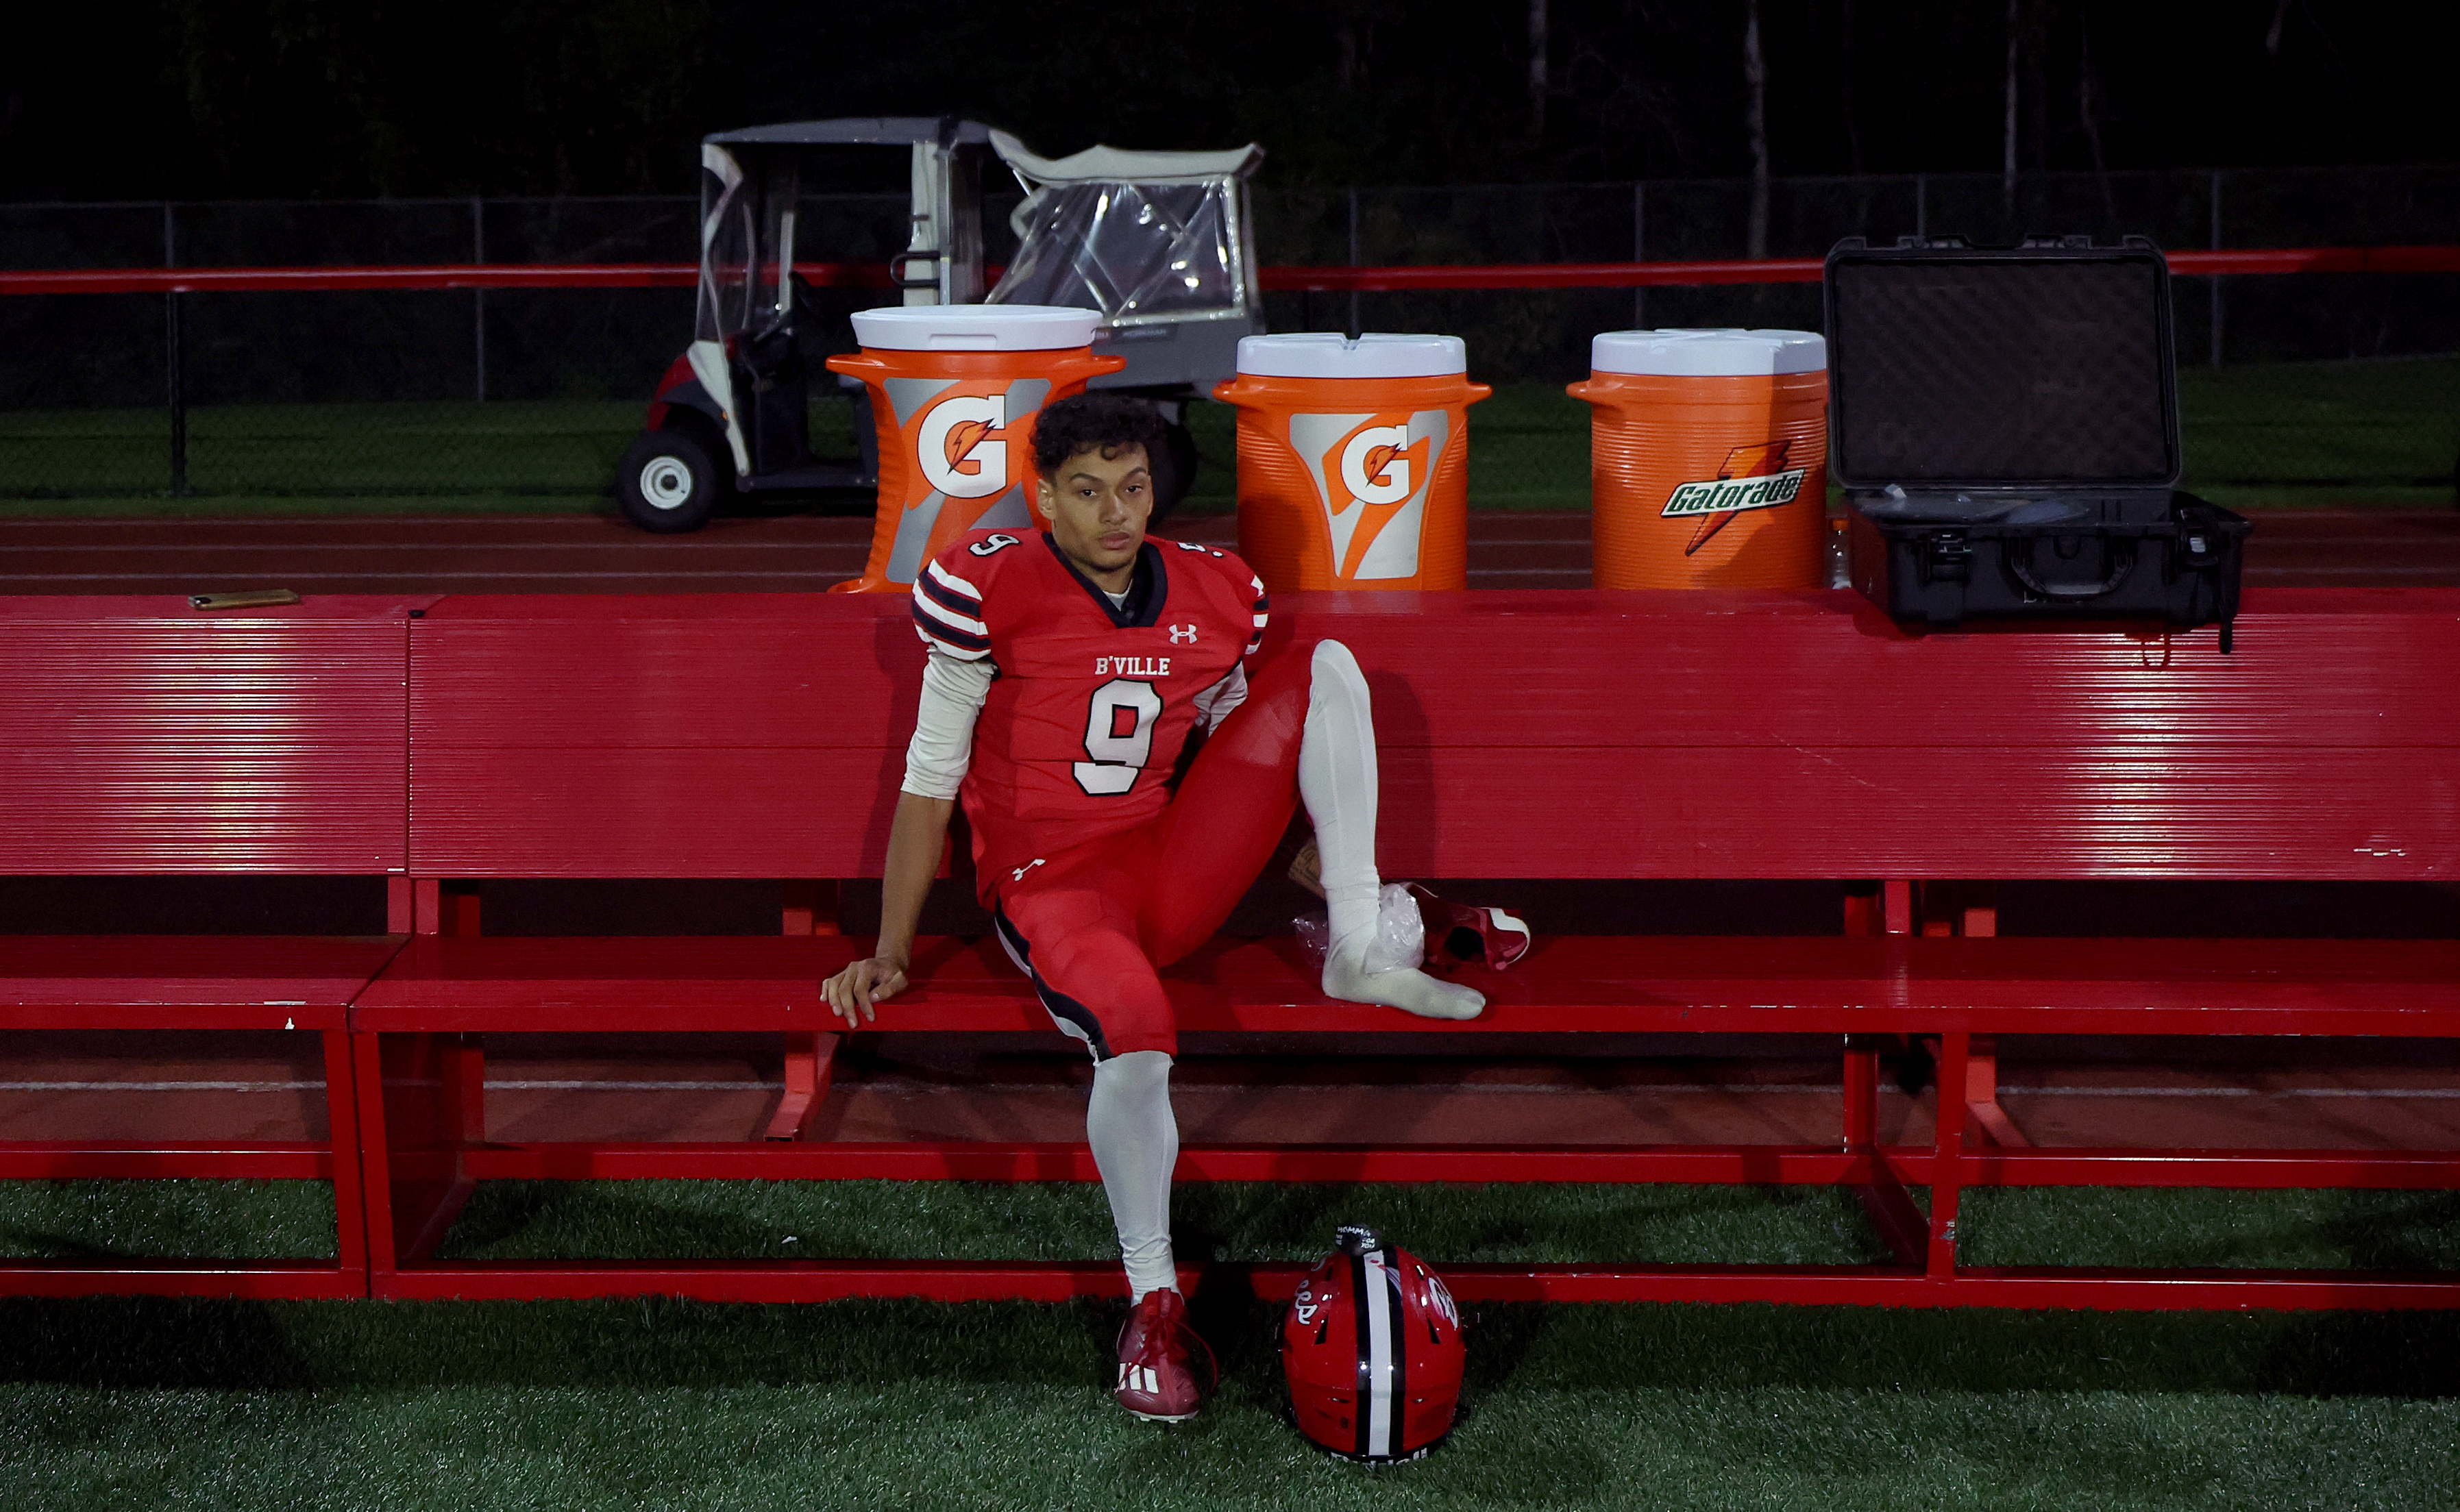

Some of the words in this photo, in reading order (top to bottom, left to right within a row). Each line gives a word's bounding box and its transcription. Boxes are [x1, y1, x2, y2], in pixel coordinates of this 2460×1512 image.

[917, 394, 1007, 499] G
[1340, 424, 1410, 505] G
[1666, 474, 1800, 512] Gatorade
[968, 533, 1021, 556] 9
[1094, 656, 1171, 676] B'VILLE
[1072, 678, 1163, 796] 9
